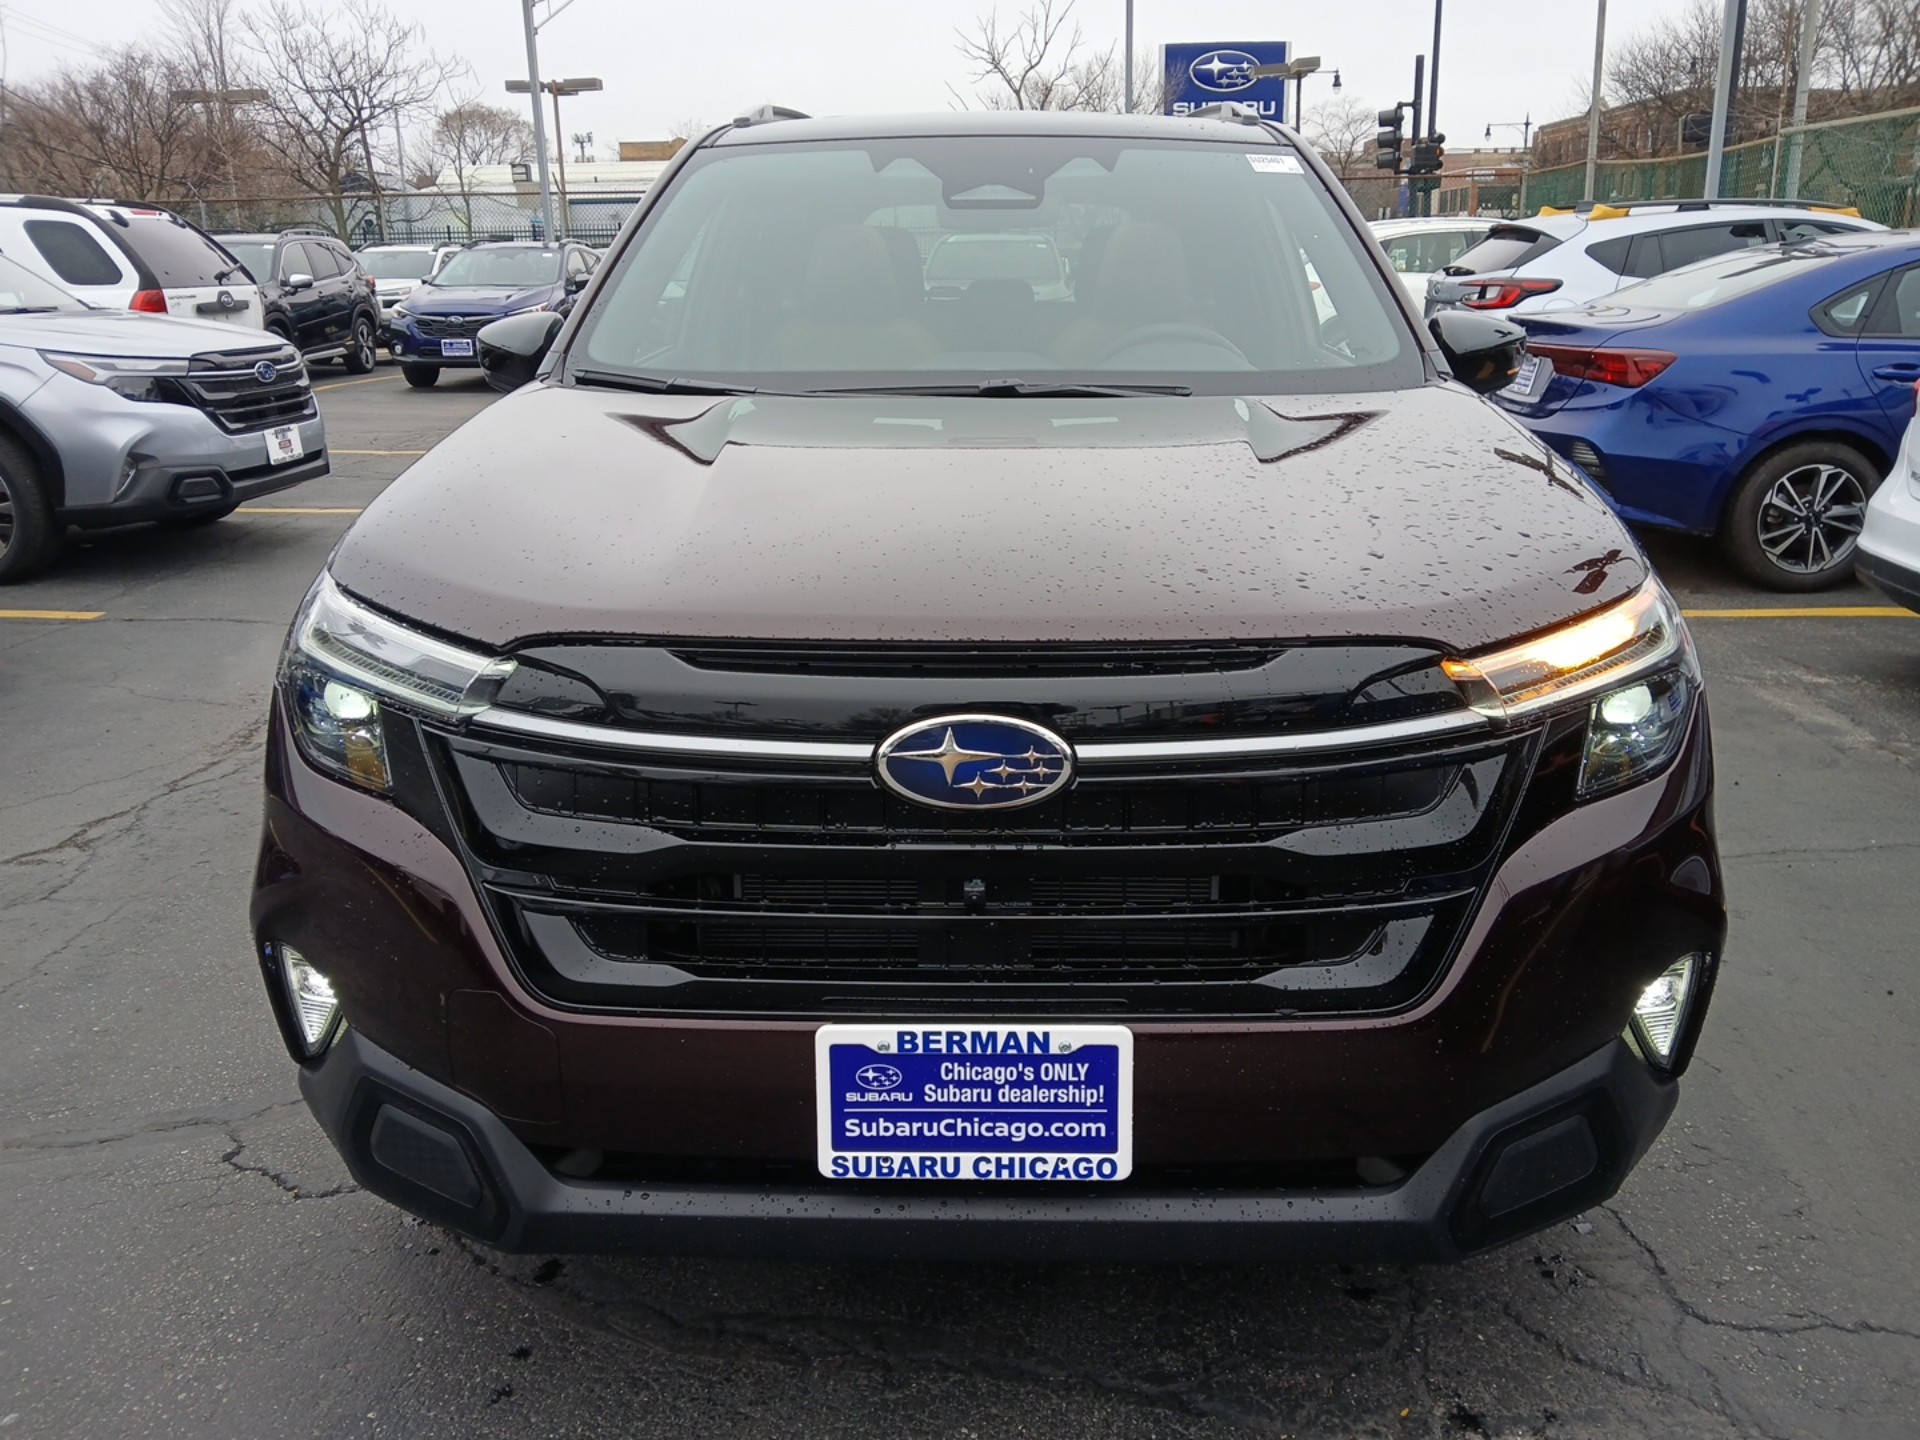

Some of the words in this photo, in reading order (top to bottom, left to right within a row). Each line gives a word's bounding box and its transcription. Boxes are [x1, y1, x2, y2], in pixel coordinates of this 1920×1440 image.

[897, 1031, 1050, 1053] BERMAN
[940, 1062, 1034, 1084] Chicago's
[1040, 1063, 1089, 1081] ONLY
[845, 1092, 913, 1102] SUBARU
[924, 1084, 991, 1102] Subaru
[998, 1085, 1104, 1106] dealership!
[844, 1118, 1106, 1142] SubaruChicago.com
[831, 1156, 961, 1178] SUBARU
[972, 1157, 1118, 1179] CHICAGO
